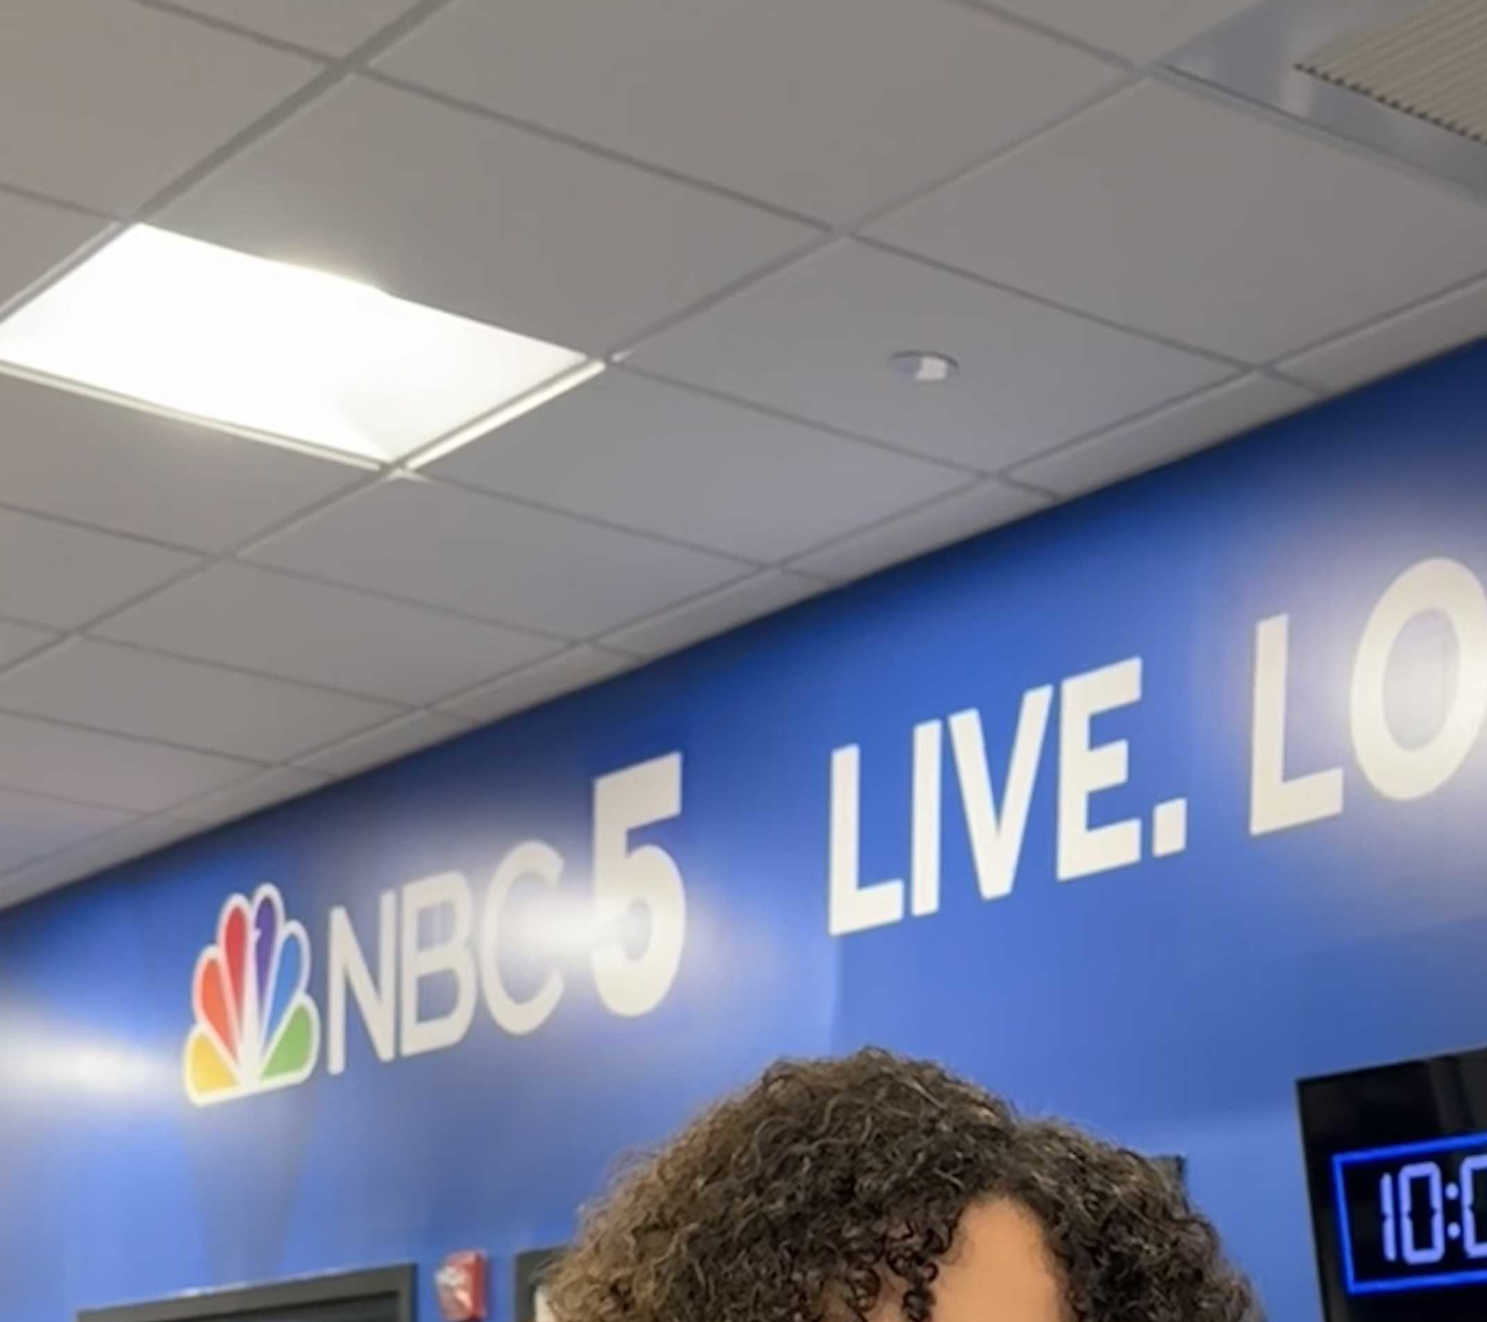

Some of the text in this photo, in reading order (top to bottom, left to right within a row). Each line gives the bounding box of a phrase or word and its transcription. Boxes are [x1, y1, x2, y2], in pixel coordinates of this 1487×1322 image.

[327, 752, 687, 1075] NBC 5
[828, 655, 1187, 937] LIVE.
